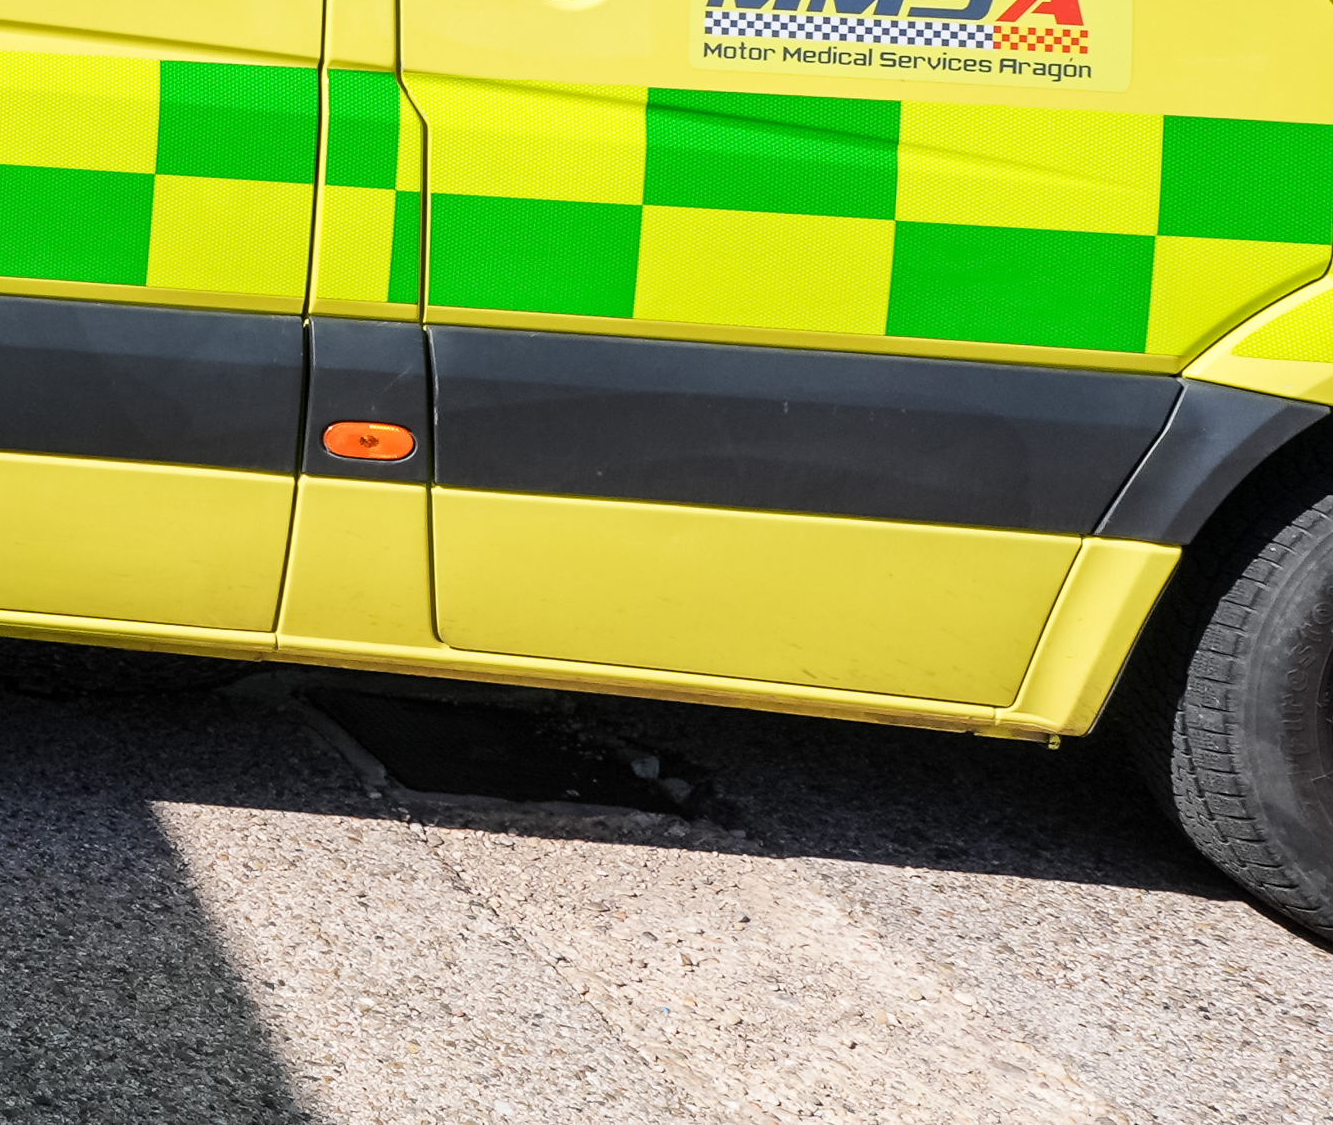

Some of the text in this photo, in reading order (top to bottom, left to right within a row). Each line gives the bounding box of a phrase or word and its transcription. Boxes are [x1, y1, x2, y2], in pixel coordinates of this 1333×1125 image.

[703, 41, 1092, 83] Motor Medical Services Aragón
